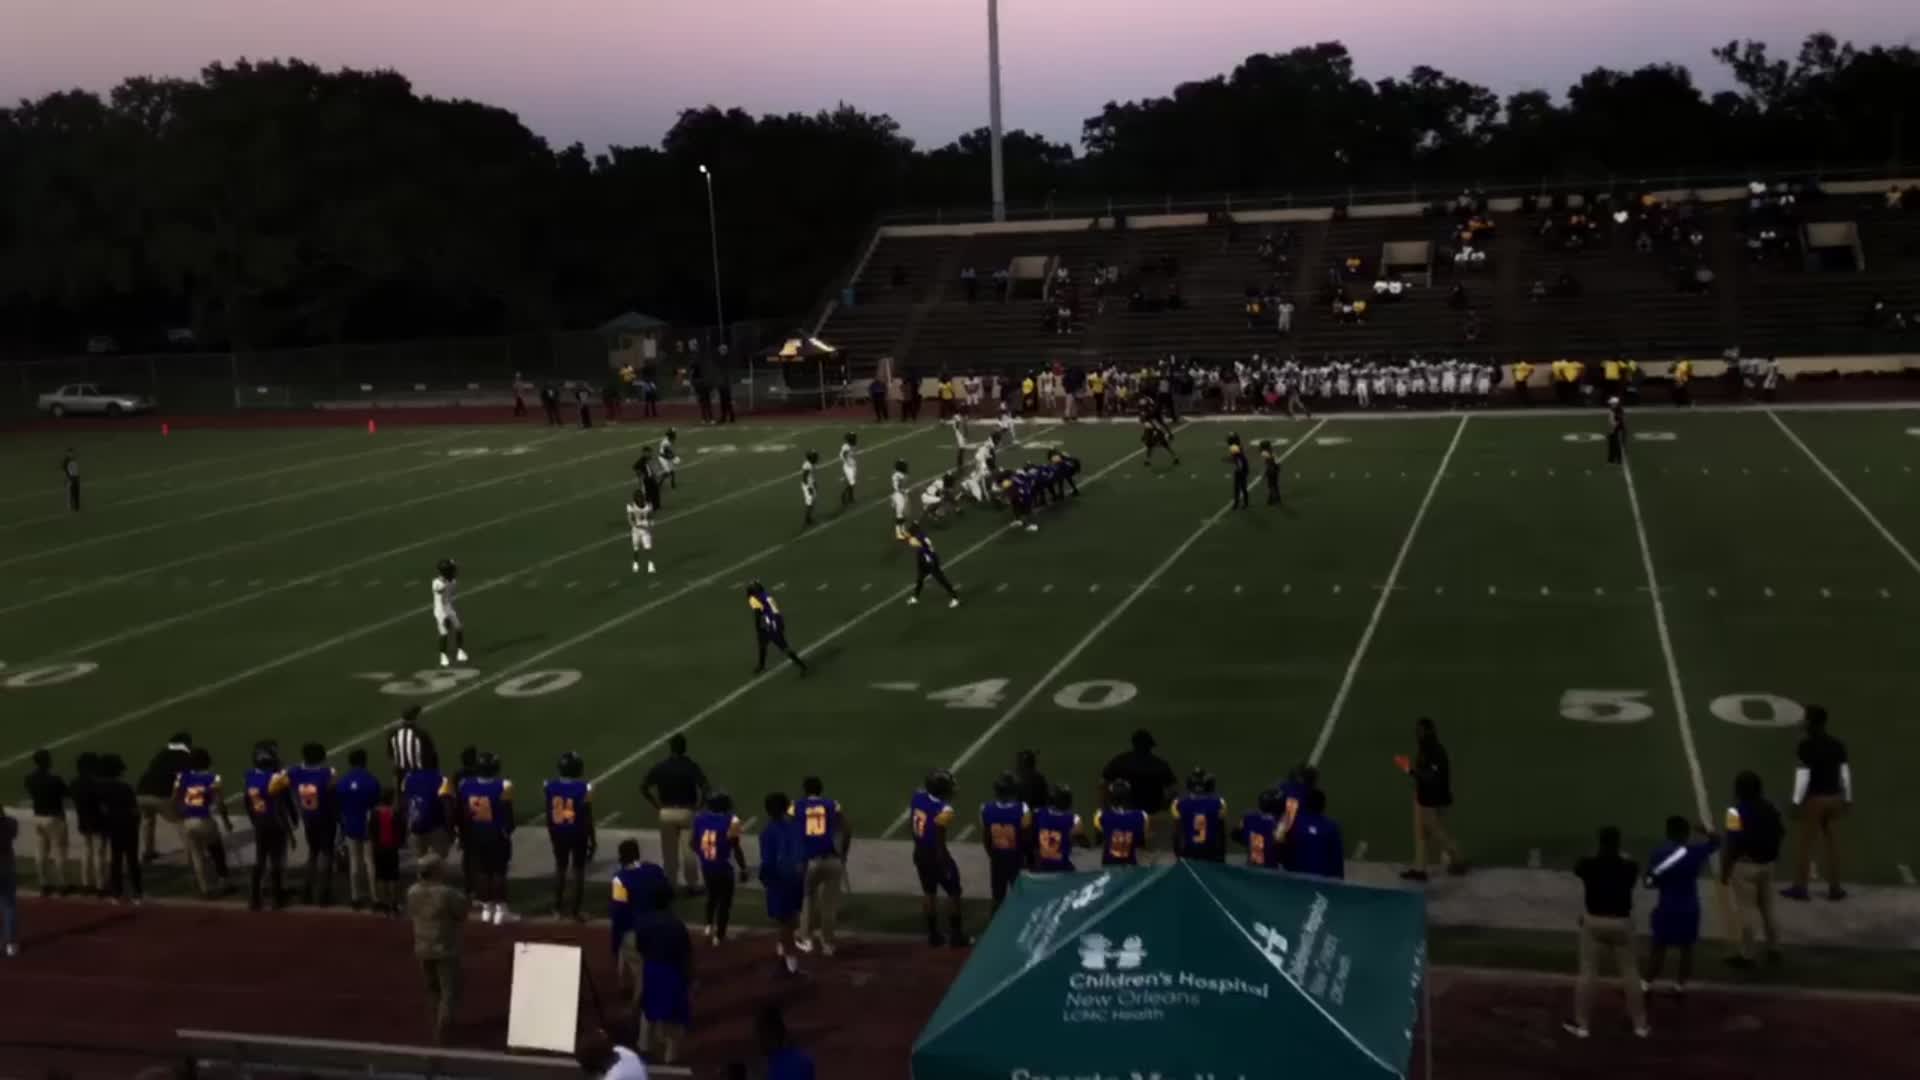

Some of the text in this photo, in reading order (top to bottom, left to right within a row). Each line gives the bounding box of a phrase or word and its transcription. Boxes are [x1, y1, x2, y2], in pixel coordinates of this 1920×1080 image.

[378, 669, 582, 697] 30
[926, 678, 1137, 710] 40
[1559, 688, 1806, 728] 50
[1066, 989, 1201, 1007] New Orleans
[1069, 970, 1269, 999] Children's Hospital
[1112, 1008, 1165, 1022] Health
